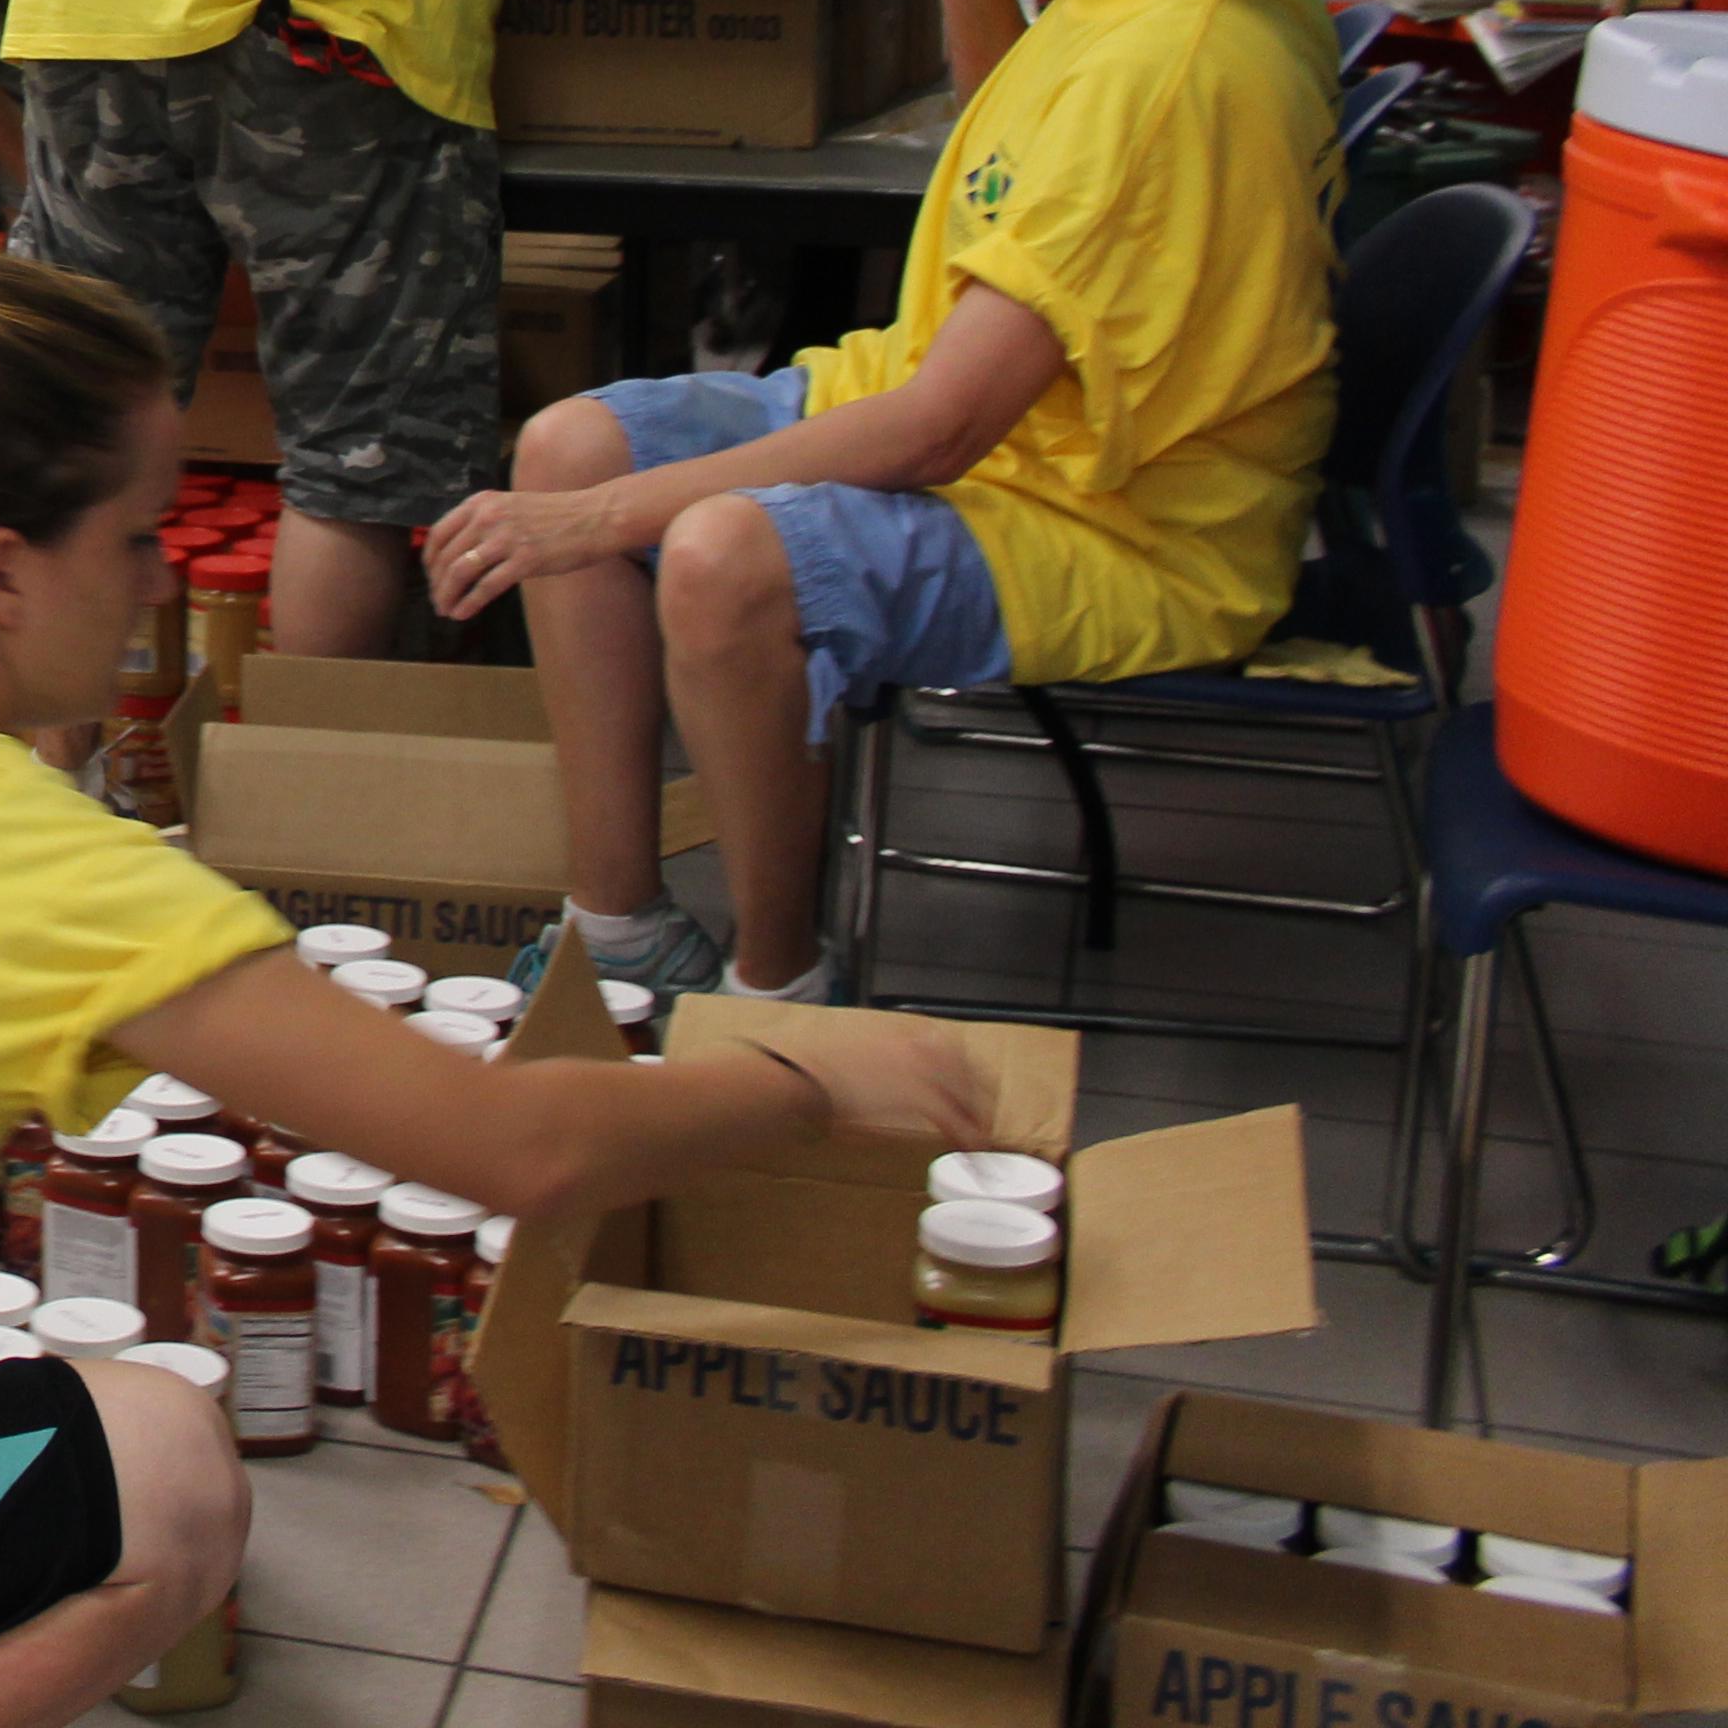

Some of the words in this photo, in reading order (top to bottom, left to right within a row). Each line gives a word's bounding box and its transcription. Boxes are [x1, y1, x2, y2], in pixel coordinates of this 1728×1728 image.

[246, 885, 421, 940] AGHETTI
[611, 1334, 800, 1412] APPLE
[818, 1356, 1022, 1447] SAUCE
